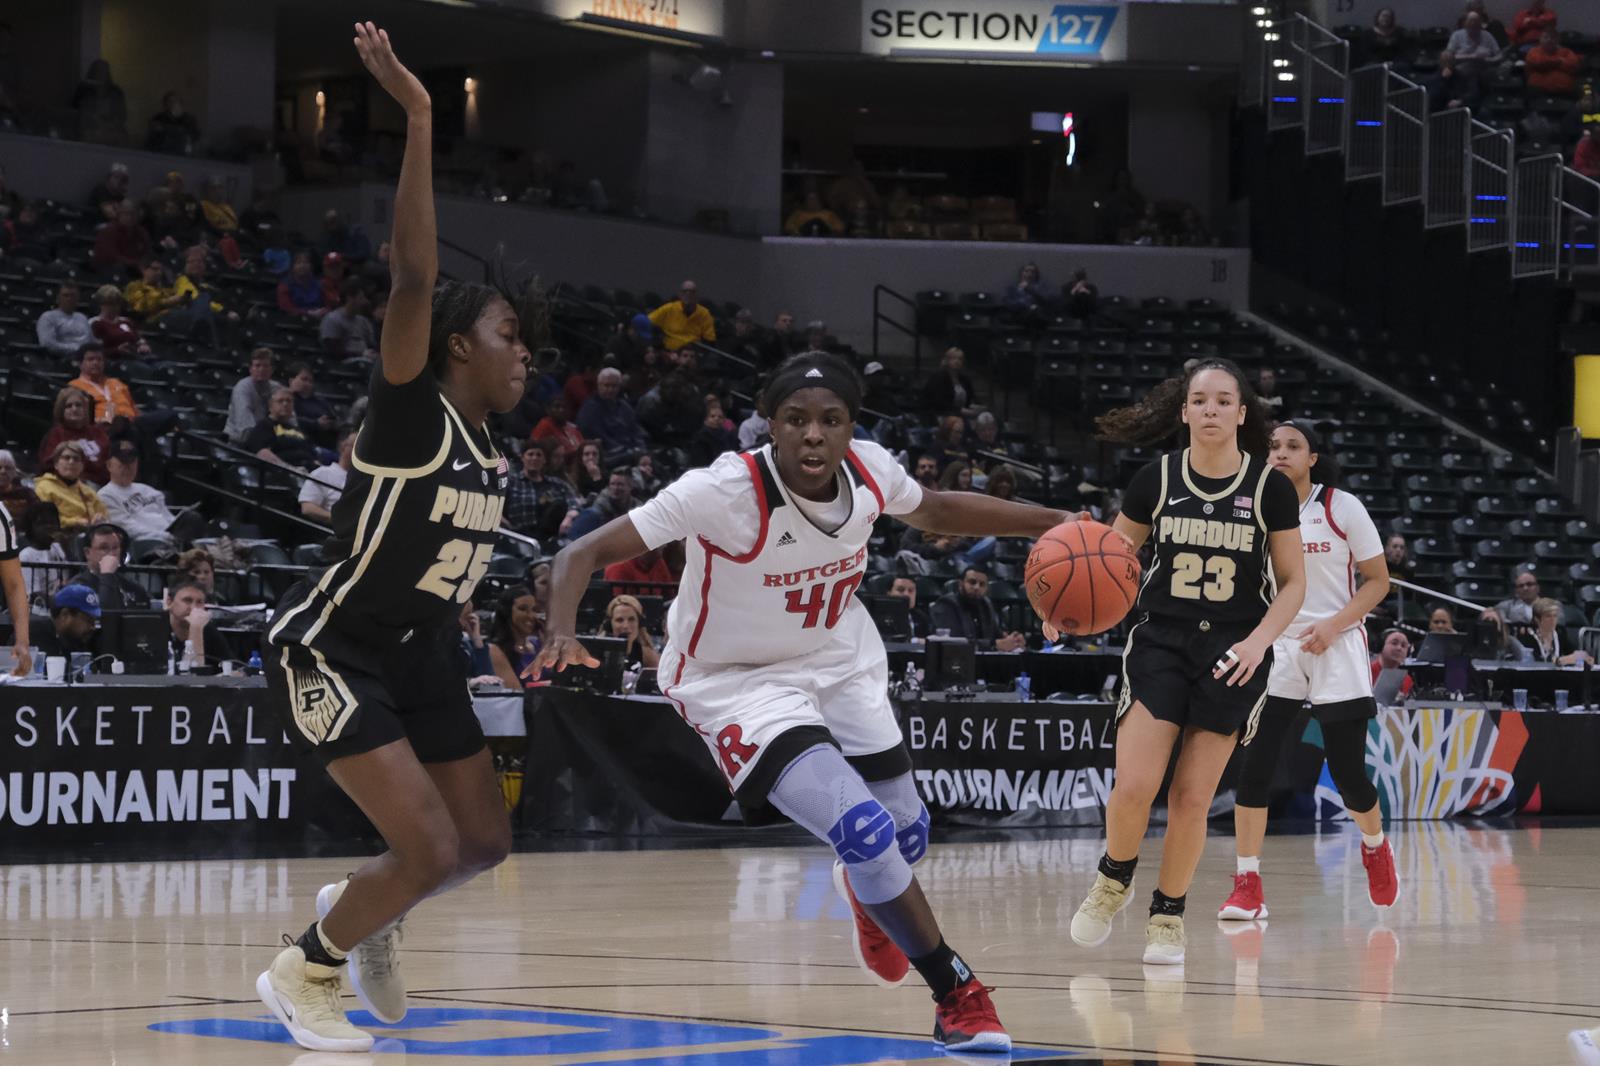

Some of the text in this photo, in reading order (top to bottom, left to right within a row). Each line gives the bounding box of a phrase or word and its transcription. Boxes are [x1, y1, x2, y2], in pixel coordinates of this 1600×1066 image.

[870, 9, 1104, 45] SECTION 127
[1159, 516, 1256, 552] PURDUE
[415, 538, 495, 604] 25
[762, 546, 866, 588] RUTGER
[1170, 552, 1237, 602] 23
[785, 570, 864, 630] 40
[302, 687, 326, 713] P
[14, 705, 292, 747] SKETBAL
[716, 723, 760, 780] R
[0, 768, 297, 827] URNAMENT
[915, 766, 1116, 811] TOURNAMEN
